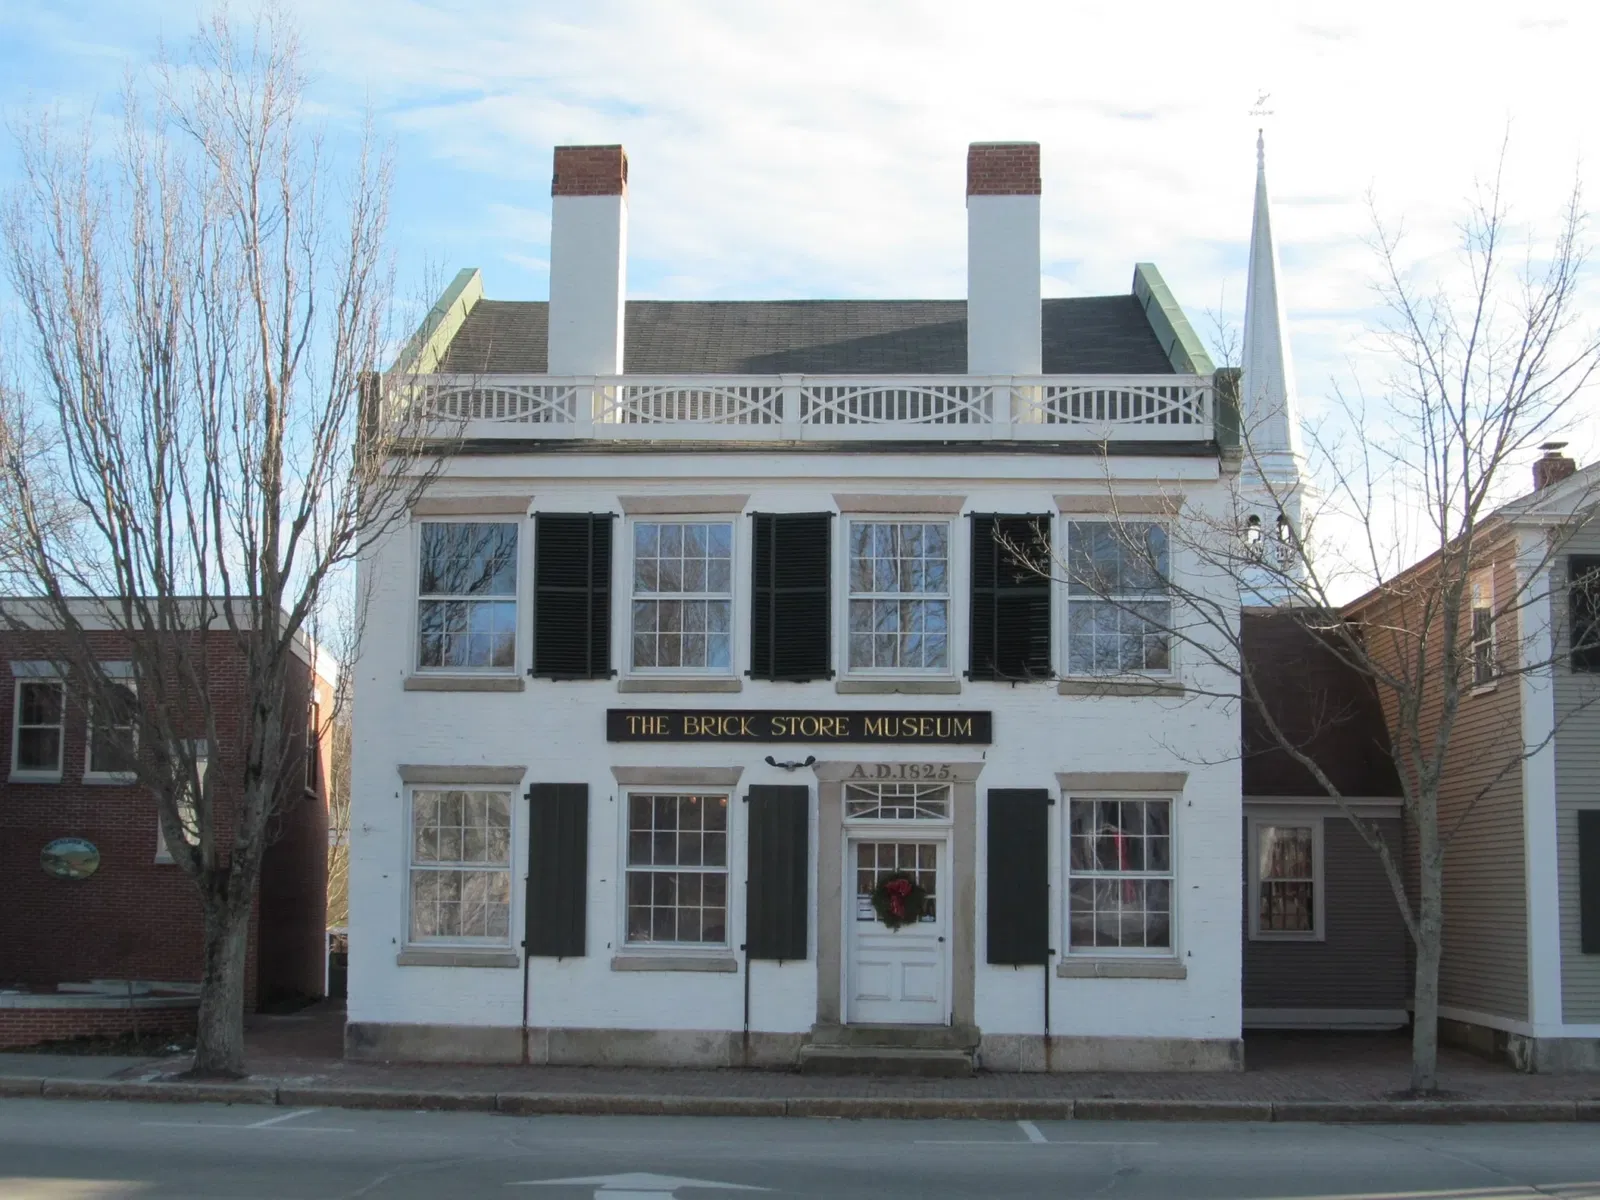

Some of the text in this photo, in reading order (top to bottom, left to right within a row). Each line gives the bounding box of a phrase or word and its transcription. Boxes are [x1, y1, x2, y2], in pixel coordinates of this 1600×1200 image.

[625, 715, 973, 738] THE BRICK STORE MUSEUM
